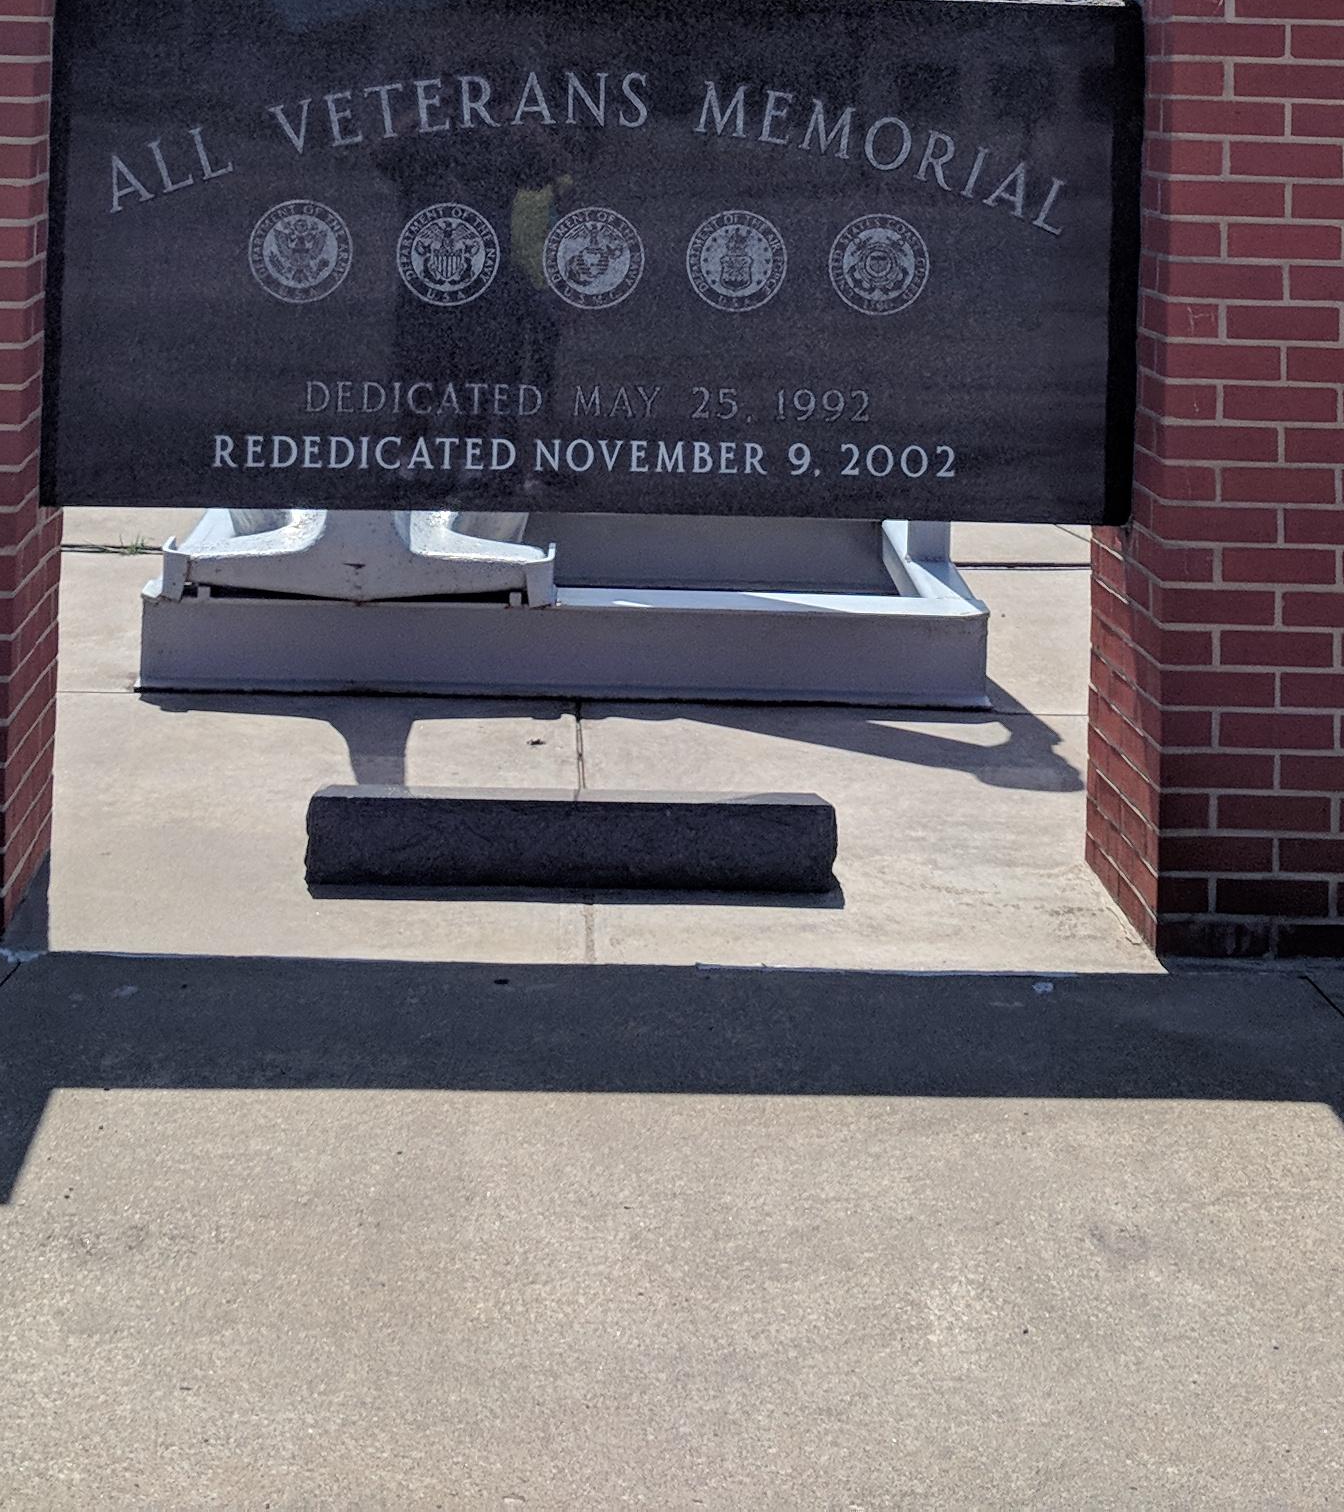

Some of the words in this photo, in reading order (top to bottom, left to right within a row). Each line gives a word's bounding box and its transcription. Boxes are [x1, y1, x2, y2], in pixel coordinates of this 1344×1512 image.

[110, 126, 233, 213] ALL
[268, 71, 649, 154] VETERANS
[694, 80, 1066, 236] MEMORIAL
[451, 206, 471, 219] OF
[473, 219, 493, 242] THE
[723, 214, 739, 225] OF
[766, 233, 782, 253] AIR
[839, 217, 881, 244] STATES
[887, 219, 922, 250] COAST
[253, 204, 296, 278] DEPARTMENT
[303, 204, 323, 216] OF
[332, 243, 350, 281] ARMY
[400, 207, 445, 281] DEPARTMENT
[545, 211, 590, 283] DEPARTMENT
[597, 211, 616, 223] OF
[625, 252, 642, 287] NAVY
[479, 247, 497, 283] NAVY
[305, 380, 544, 418] DEDICATED
[572, 384, 660, 418] MAY
[777, 388, 872, 423] 1992
[211, 434, 517, 471] REDEDICATED
[534, 438, 769, 476] NOVEMBER
[788, 443, 821, 479] 9,
[840, 443, 957, 479] 2002
